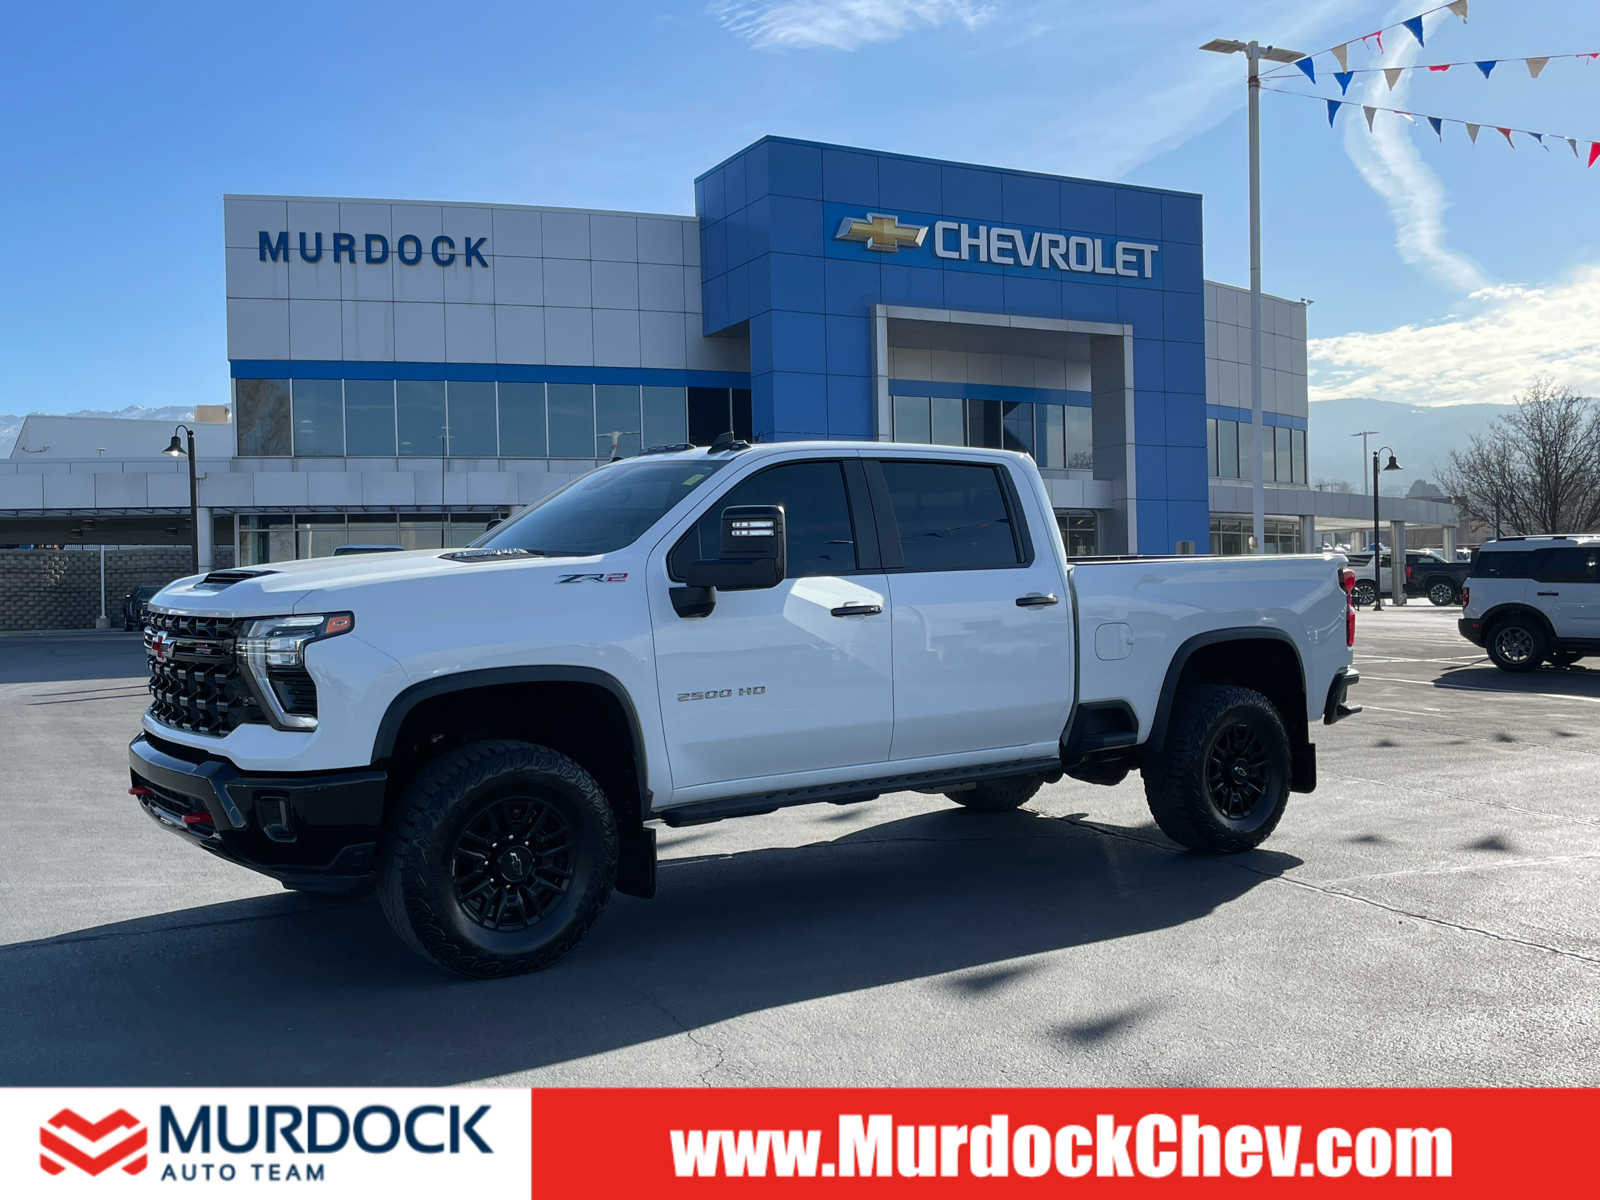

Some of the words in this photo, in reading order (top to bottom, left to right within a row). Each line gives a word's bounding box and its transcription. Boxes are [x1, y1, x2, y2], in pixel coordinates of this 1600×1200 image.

[258, 230, 489, 268] MURDOCK
[934, 220, 1158, 278] CHEVROLET
[557, 572, 629, 584] ZR2
[677, 688, 733, 702] 2500
[738, 685, 766, 697] HD
